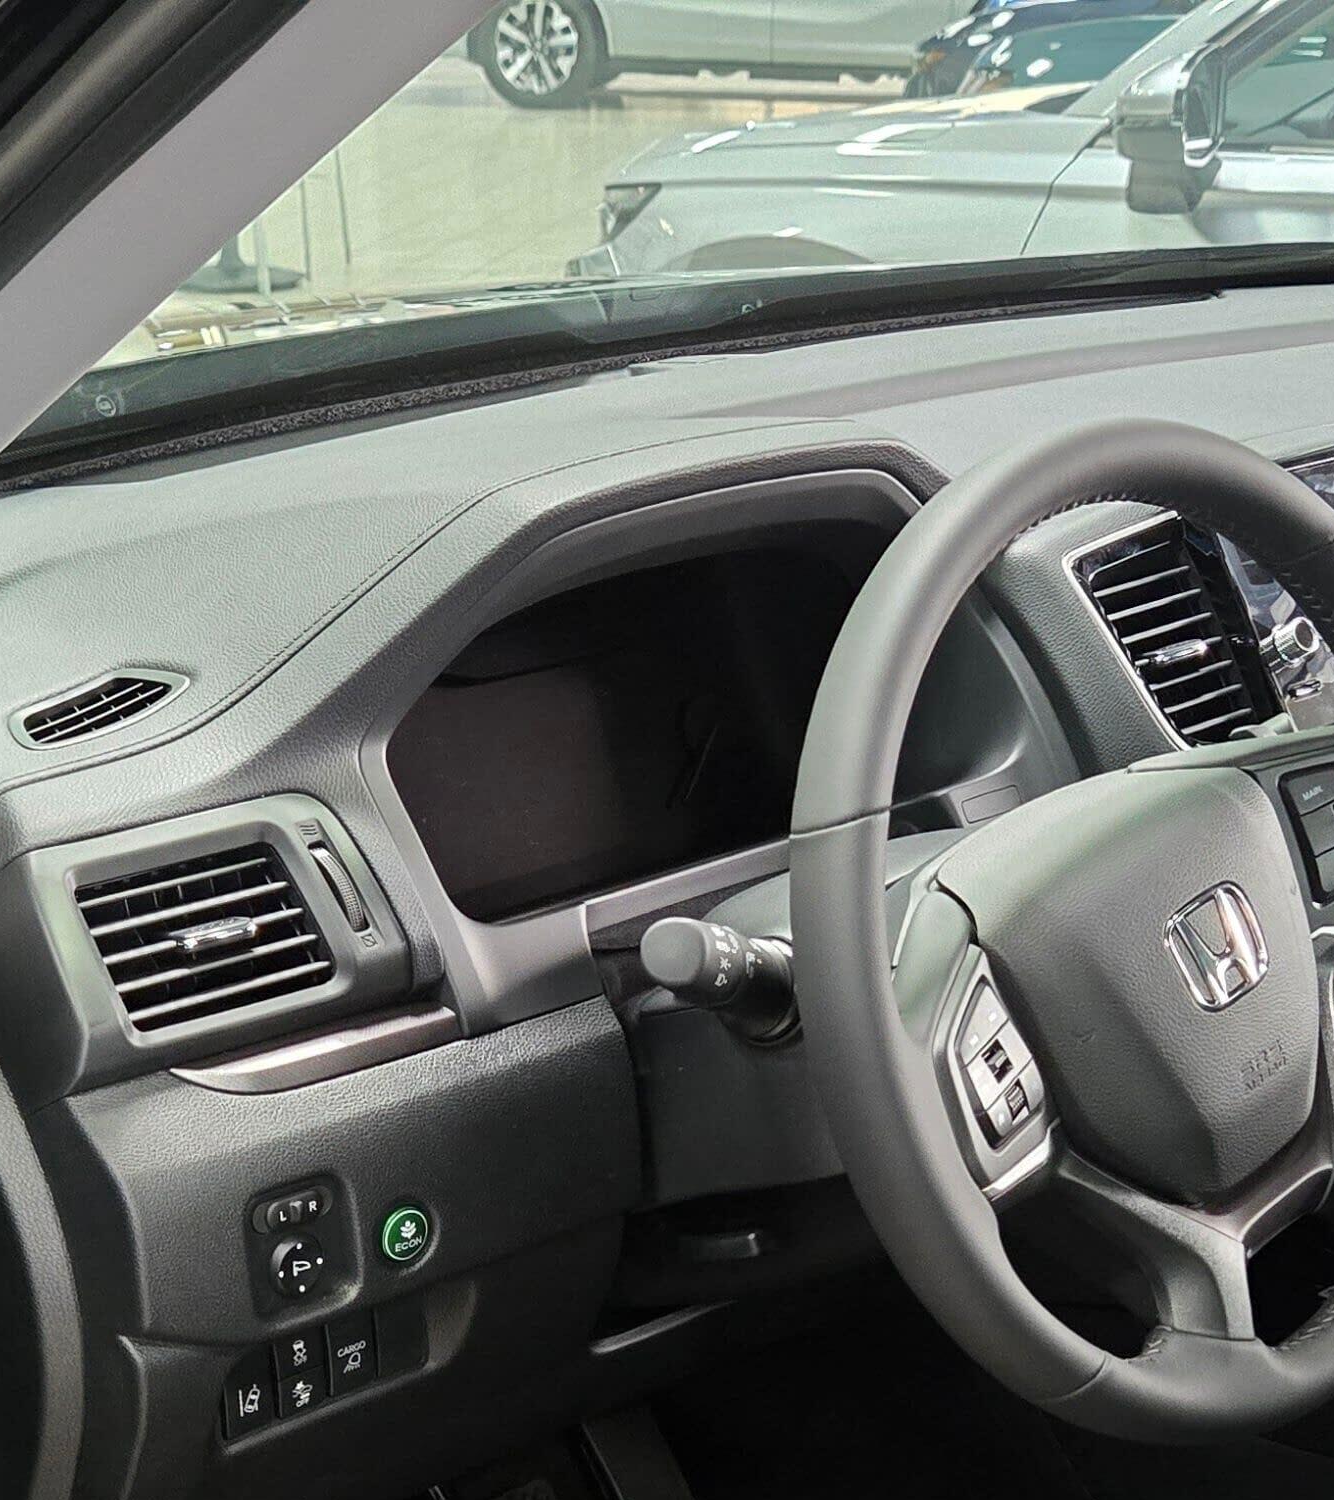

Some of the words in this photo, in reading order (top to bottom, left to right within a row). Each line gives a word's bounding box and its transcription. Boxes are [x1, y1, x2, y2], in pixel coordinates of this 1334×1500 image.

[279, 1210, 288, 1222] L
[308, 1200, 317, 1213] R
[394, 1235, 423, 1253] ECON
[337, 1339, 367, 1358] CARGO
